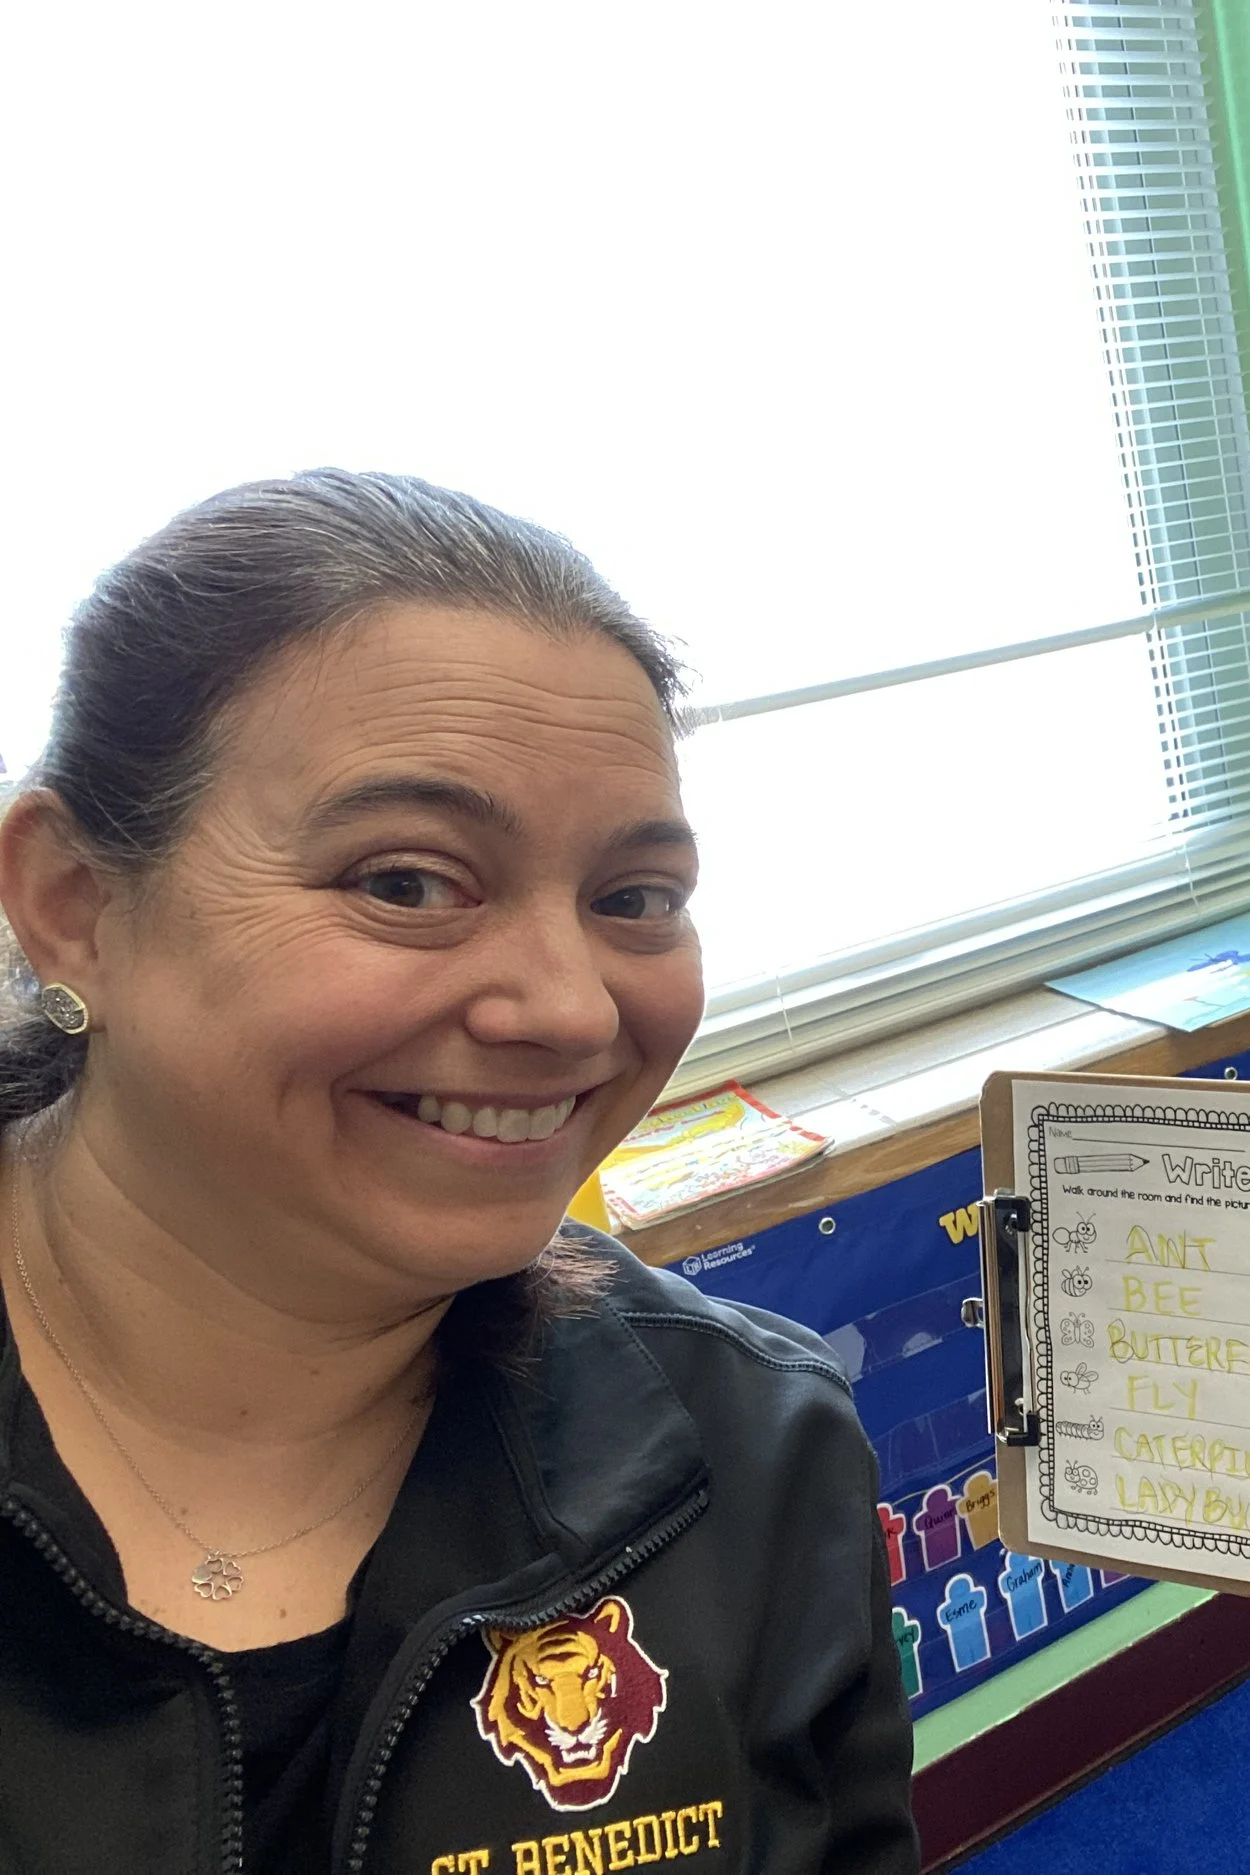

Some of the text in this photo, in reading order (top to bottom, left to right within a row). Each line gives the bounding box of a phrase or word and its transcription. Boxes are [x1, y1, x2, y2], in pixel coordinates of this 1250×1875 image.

[1049, 1126, 1072, 1139] Name
[1062, 1184, 1084, 1196] Walk
[1087, 1187, 1118, 1199] around
[1121, 1190, 1135, 1200] the
[1137, 1193, 1162, 1202] room
[1165, 1193, 1182, 1204] and
[1185, 1194, 1204, 1206] find
[1206, 1196, 1221, 1207] the
[701, 1242, 744, 1262] Learning
[1125, 1224, 1217, 1272] ANT
[1122, 1275, 1203, 1317] BEE
[1127, 1375, 1198, 1421] FLY
[965, 1488, 996, 1513] Briggs
[1005, 1562, 1043, 1592] Graham
[945, 1598, 978, 1623] Esme
[511, 1801, 723, 1875] BENEDICT
